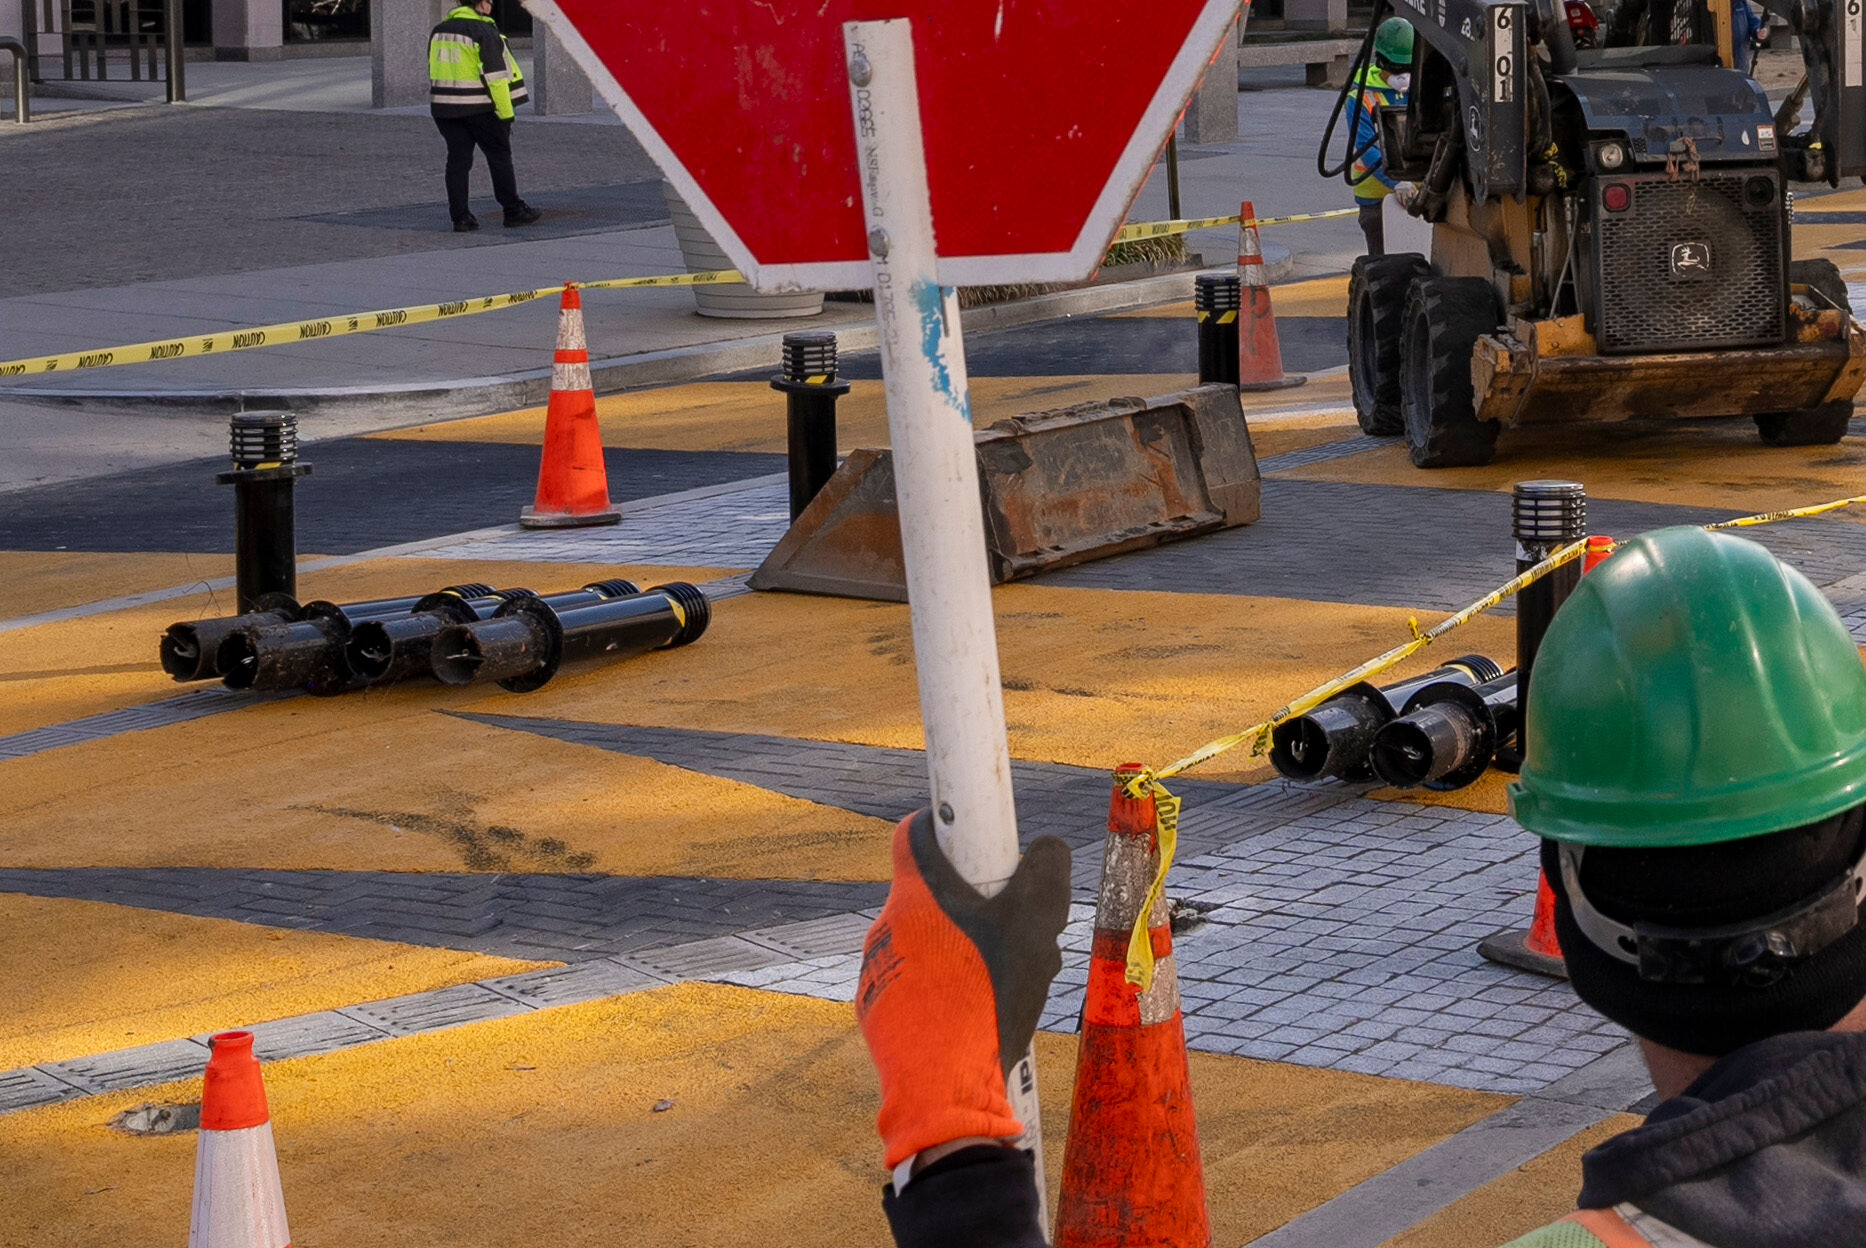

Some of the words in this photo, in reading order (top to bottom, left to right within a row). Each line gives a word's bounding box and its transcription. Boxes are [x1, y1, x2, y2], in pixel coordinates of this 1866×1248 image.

[0, 364, 26, 376] CAUTI
[76, 352, 113, 369] CAUTION
[149, 342, 185, 360] CAUTION
[231, 331, 266, 349] CAUTION
[300, 321, 332, 339] CAUTION
[375, 309, 407, 328] CAUTION
[438, 301, 469, 317] CAUTION
